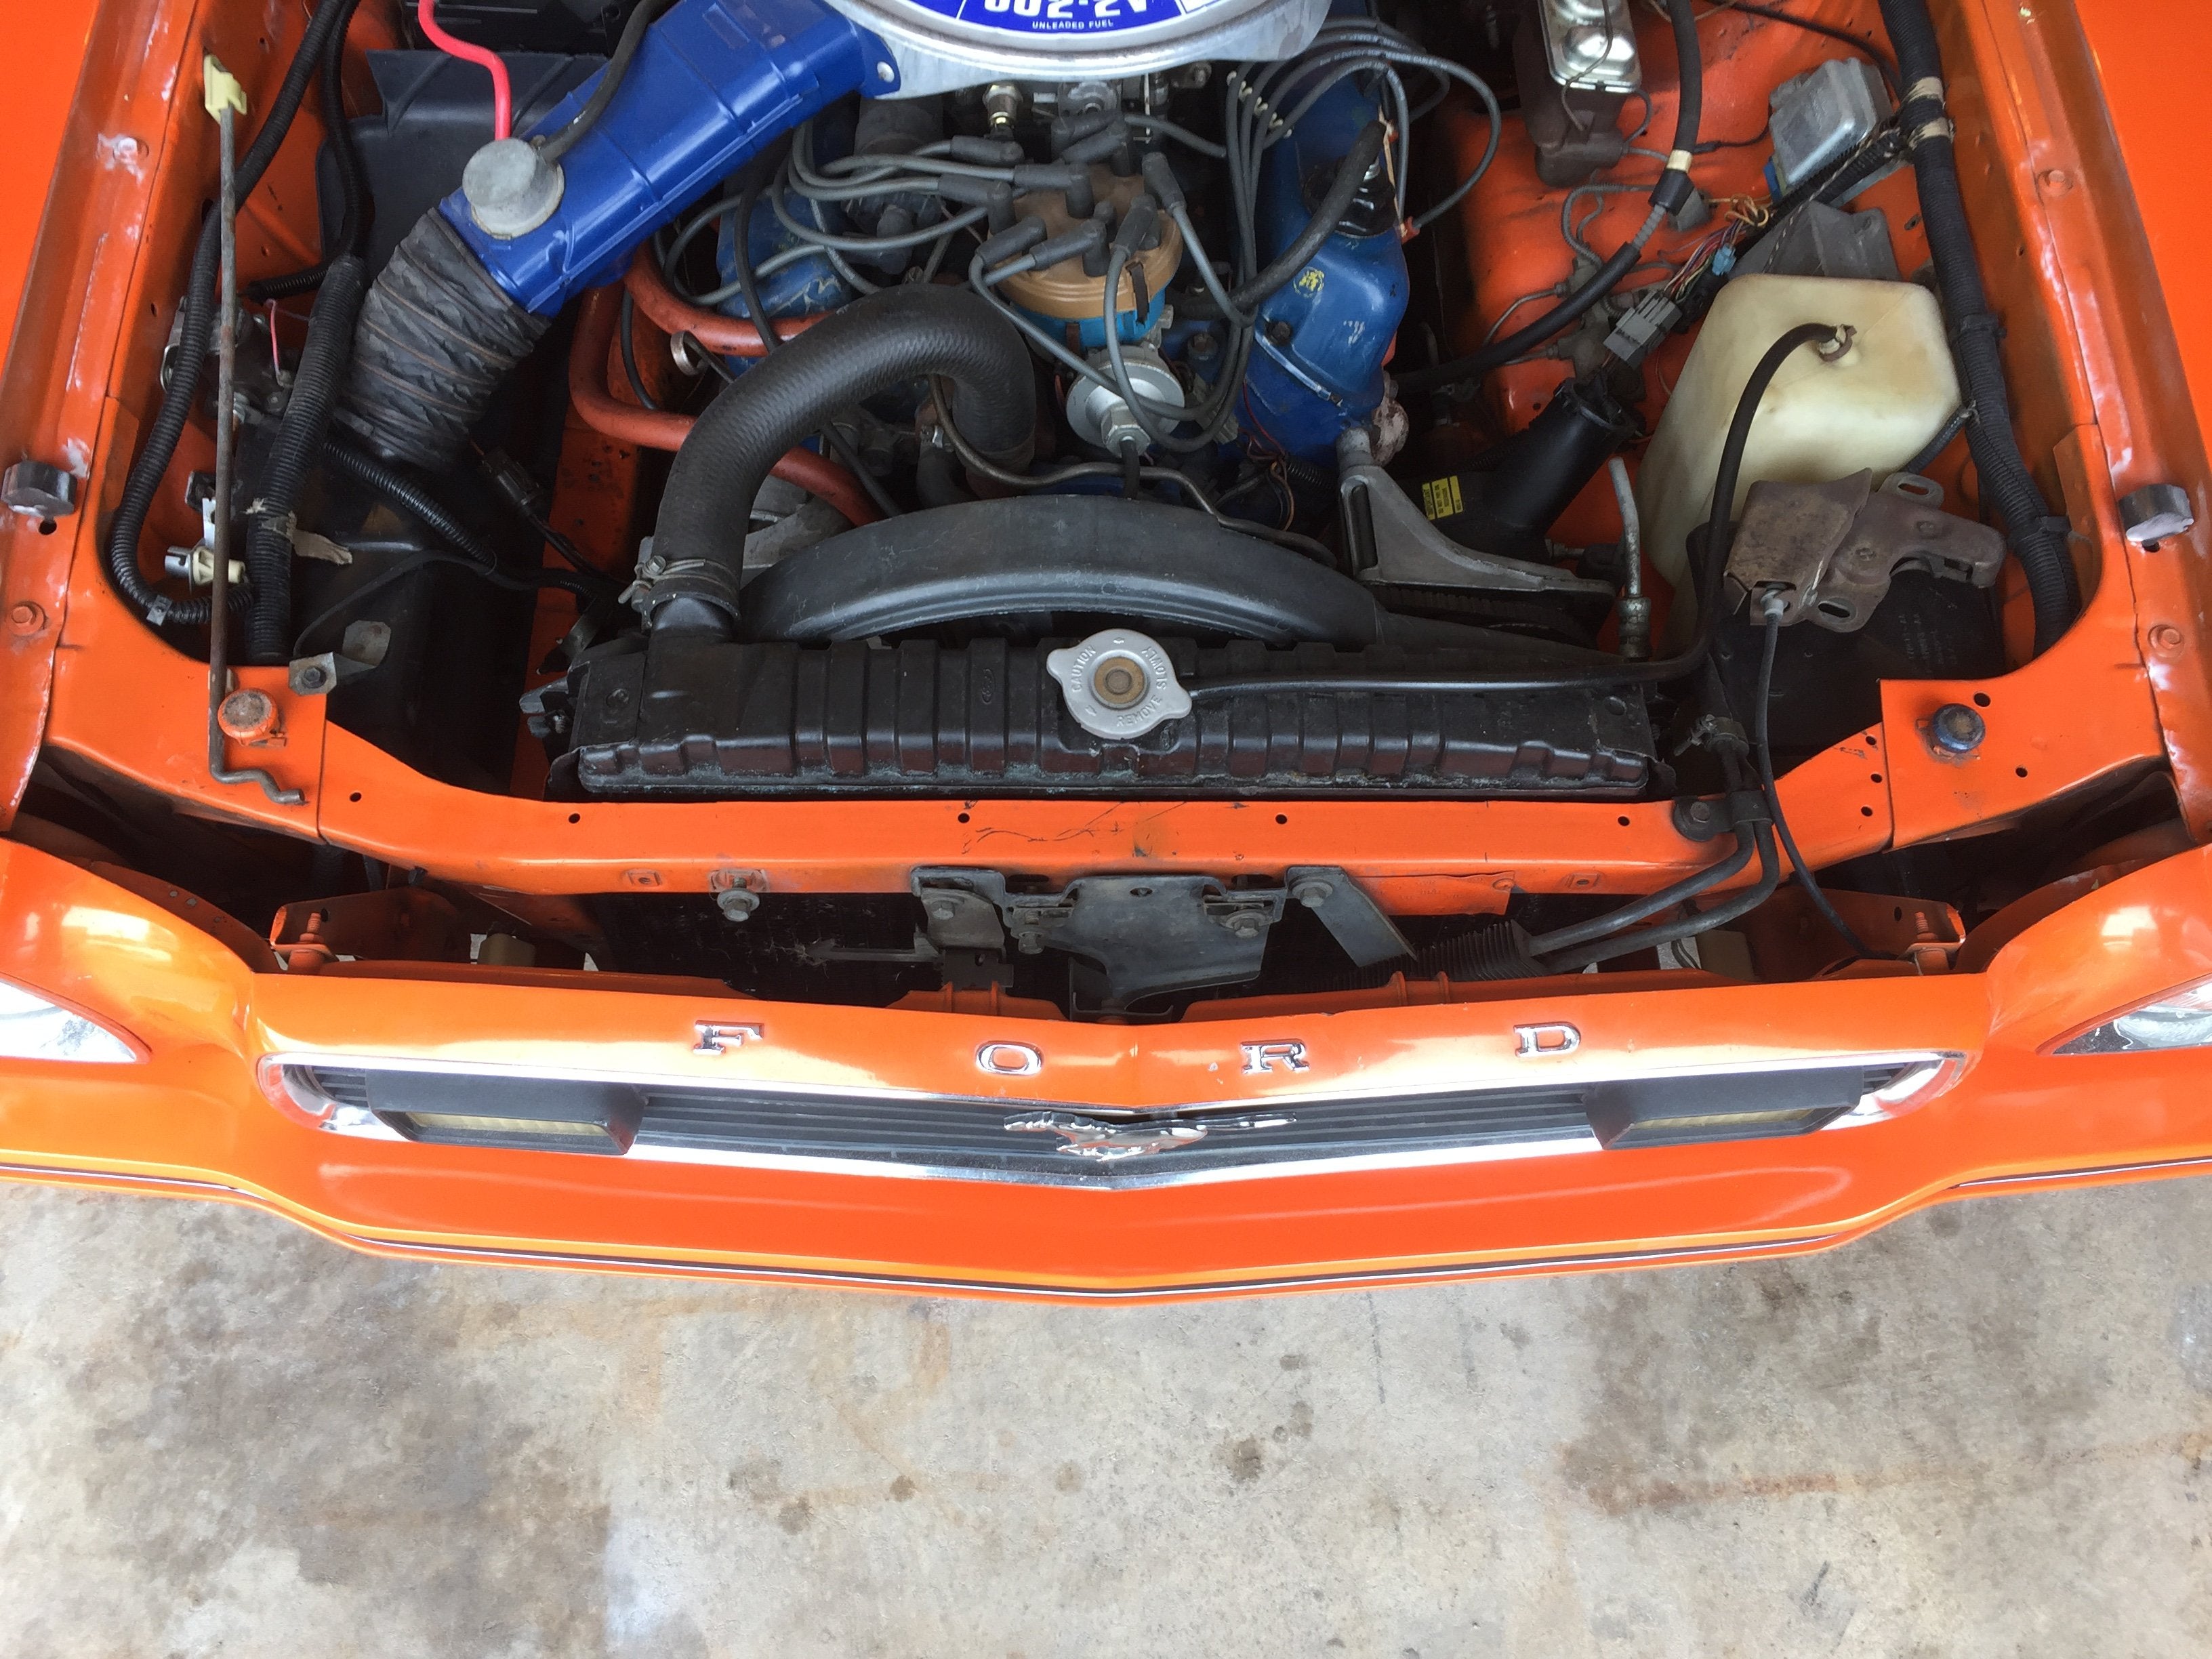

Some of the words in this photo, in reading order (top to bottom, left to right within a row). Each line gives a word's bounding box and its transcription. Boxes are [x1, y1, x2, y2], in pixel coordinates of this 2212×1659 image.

[1032, 21, 1084, 30] UNLEADED
[1089, 19, 1113, 28] FUEL
[1071, 646, 1096, 693] CAUTION
[1116, 695, 1162, 727] REMOVE
[1141, 647, 1168, 690] SLOWLY
[693, 1019, 1582, 1076] FORD
